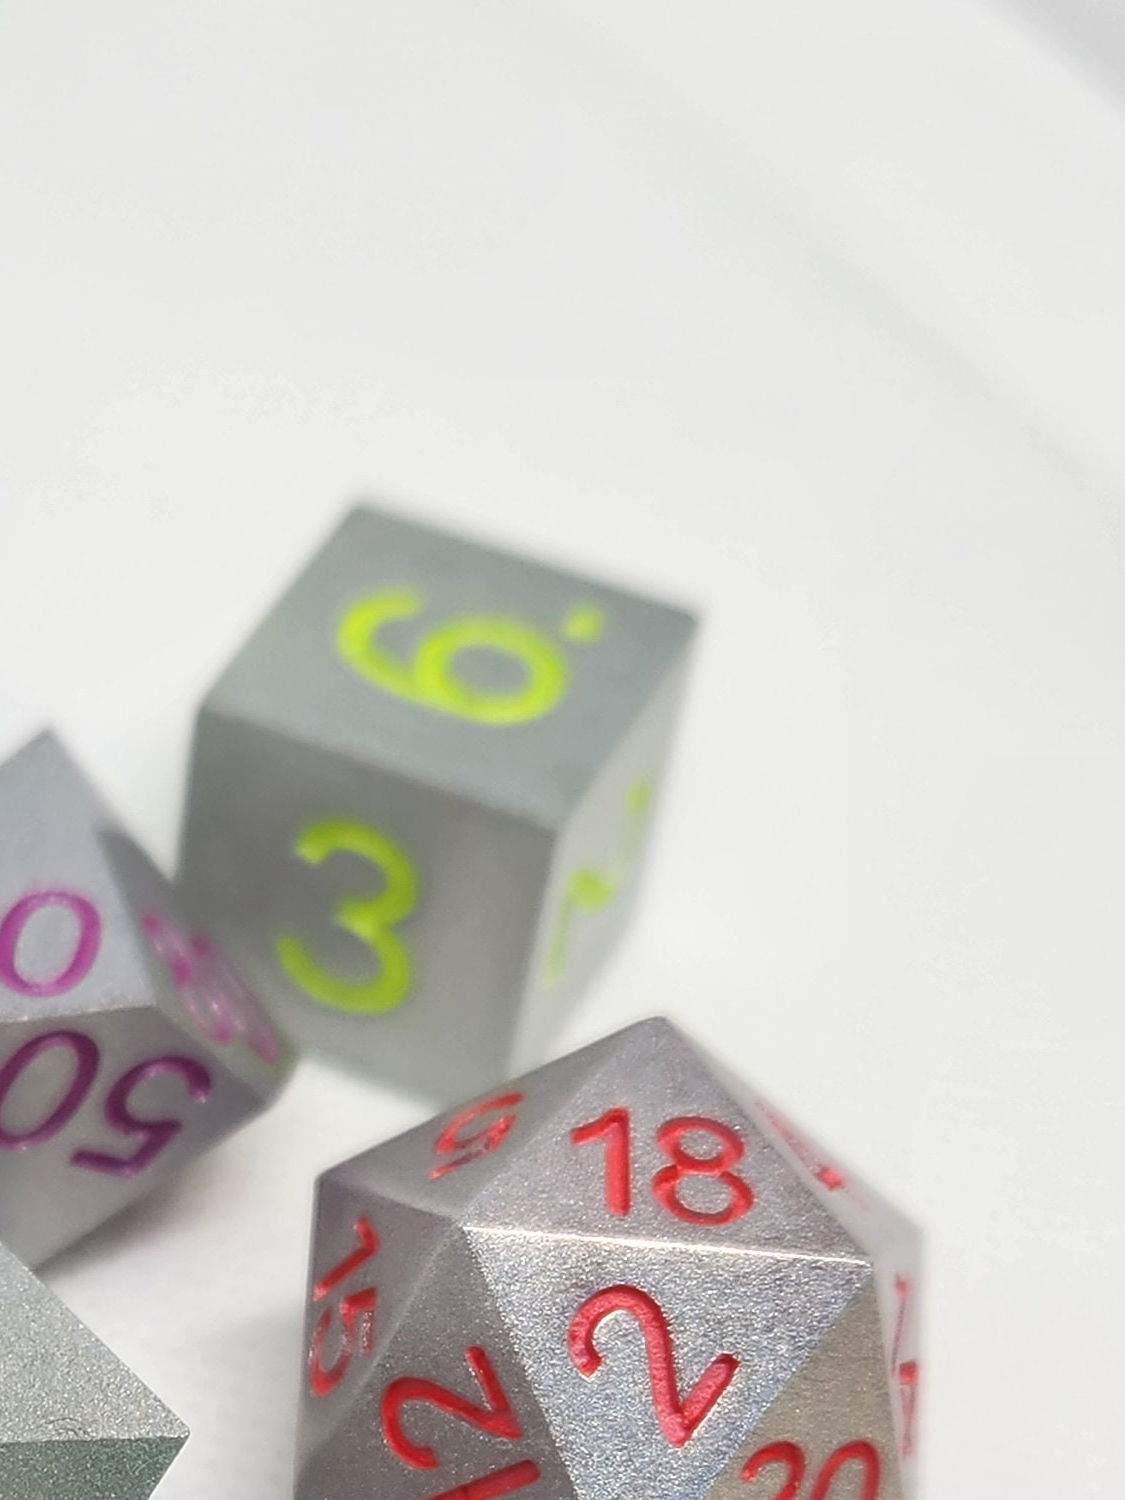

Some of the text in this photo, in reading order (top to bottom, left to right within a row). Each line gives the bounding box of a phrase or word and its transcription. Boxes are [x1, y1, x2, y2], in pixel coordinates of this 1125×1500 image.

[277, 816, 418, 1014] 3
[570, 1107, 755, 1226] 18
[309, 1214, 380, 1397] 15
[567, 1284, 741, 1449] 2
